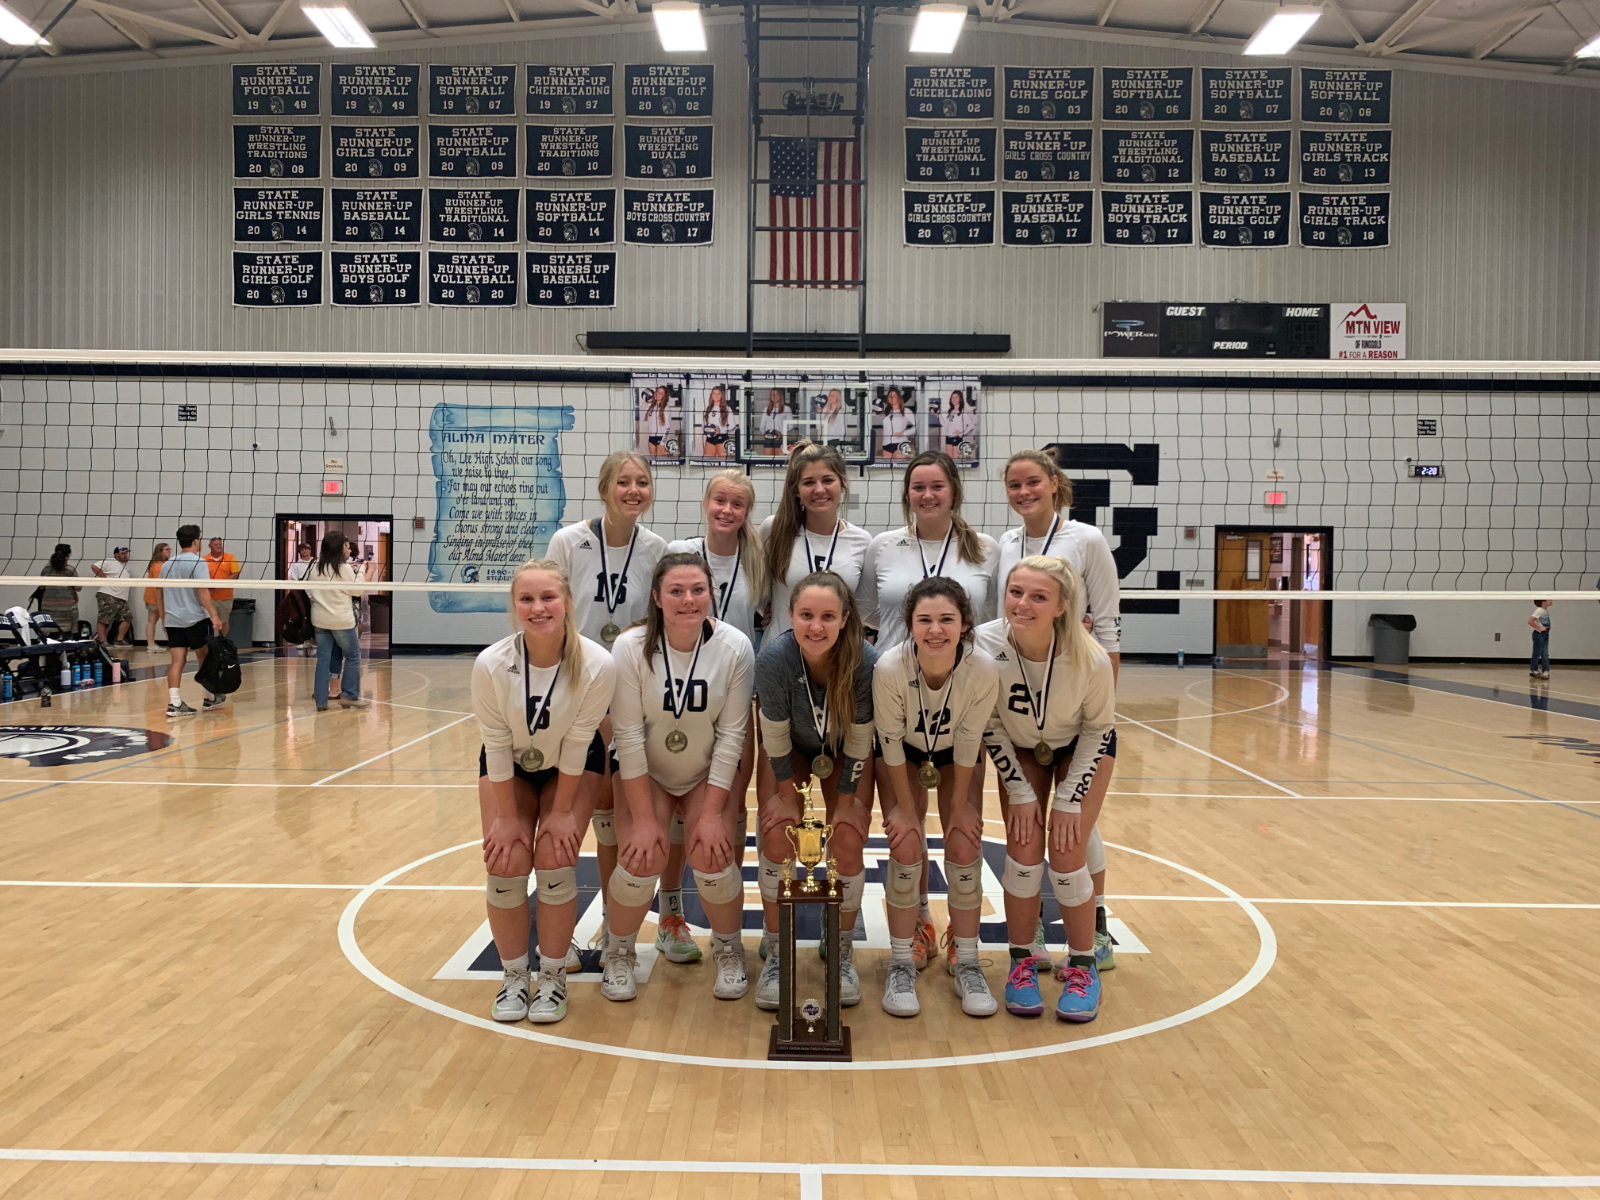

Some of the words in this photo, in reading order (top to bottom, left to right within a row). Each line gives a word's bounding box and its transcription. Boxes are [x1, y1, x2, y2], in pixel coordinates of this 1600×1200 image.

[257, 67, 297, 76] STATE
[549, 68, 589, 76] STATE
[930, 69, 971, 78] STATE
[241, 76, 313, 85] RUNNER-UP
[534, 76, 606, 85] RUNNER-UP
[1325, 72, 1367, 81] STATE
[913, 79, 987, 87] RUNNER-UP
[1309, 81, 1383, 90] RUNNER-UP
[244, 86, 310, 95] FOOTBALL
[529, 86, 610, 95] CHEERLEADING
[910, 89, 991, 98] CHEERLEADING
[1311, 91, 1380, 101] SOFTBALL
[248, 101, 259, 109] 19
[294, 101, 306, 109] 48
[540, 101, 550, 109] 19
[586, 101, 598, 109] 97
[919, 103, 932, 112] 20
[968, 104, 980, 112] 02
[1320, 108, 1332, 116] 20
[1359, 108, 1371, 117] 08
[934, 130, 968, 138] STATE
[1324, 133, 1367, 142] STATE
[639, 135, 698, 143] RUNNER-UP
[922, 138, 980, 146] RUNNER-UP
[248, 143, 306, 151] WRESTLING
[638, 143, 698, 151] WRESTLING
[1310, 143, 1382, 152] RUNNER-UP
[247, 151, 307, 159] TRADITIONS
[651, 151, 686, 159] DUALS
[916, 154, 986, 162] TRADITIONAL
[1303, 153, 1341, 162] GIRLS
[1345, 153, 1388, 162] TRACK
[249, 164, 262, 173] 20
[292, 165, 304, 174] 08
[640, 166, 653, 174] 20
[686, 165, 696, 174] 10
[920, 167, 932, 176] 20
[970, 167, 980, 176] 11
[1313, 168, 1326, 177] 20
[1364, 168, 1375, 177] 13
[258, 191, 299, 200] STATE
[647, 193, 690, 202] STATE
[928, 194, 972, 203] STATE
[1223, 196, 1267, 205] STATE
[243, 201, 314, 210] RUNNER-UP
[633, 203, 704, 212] RUNNER-UP
[914, 204, 986, 213] RUNNER-UP
[1208, 206, 1281, 215] RUNNER-UP
[236, 211, 272, 220] GIRLS
[276, 211, 320, 220] TENNIS
[626, 212, 646, 221] BOYS
[648, 213, 673, 223] CROSS
[674, 212, 710, 222] COUNTRY
[908, 213, 930, 223] GIRLS
[932, 214, 956, 223] CROSS
[957, 213, 992, 223] COUNTRY
[1209, 215, 1244, 225] GIRLS
[1250, 215, 1281, 224] GOLF
[247, 226, 260, 235] 20
[296, 226, 307, 235] 14
[637, 228, 649, 237] 20
[687, 228, 698, 237] 17
[918, 229, 931, 238] 20
[968, 229, 979, 238] 17
[1213, 231, 1226, 239] 20
[1263, 231, 1275, 239] 18
[549, 255, 592, 264] STATE
[532, 265, 591, 274] RUNNERS
[594, 265, 610, 273] UP
[543, 275, 599, 284] BASEBALL
[539, 290, 553, 299] 20
[589, 290, 600, 299] 21
[1166, 307, 1205, 316] GUEST
[1286, 308, 1320, 317] HOME
[1346, 321, 1370, 334] MTN
[1373, 321, 1400, 334] VIEW
[1356, 340, 1360, 348] OF
[443, 433, 484, 443] ALMA
[493, 434, 545, 445] MATER
[474, 451, 494, 469] High
[496, 451, 519, 466] School
[522, 456, 533, 465] our
[536, 457, 552, 471] song
[495, 481, 516, 494] echoes
[519, 481, 533, 499] ring
[537, 484, 548, 494] out
[449, 507, 469, 519] Come
[485, 507, 502, 519] with
[663, 678, 708, 712] 20
